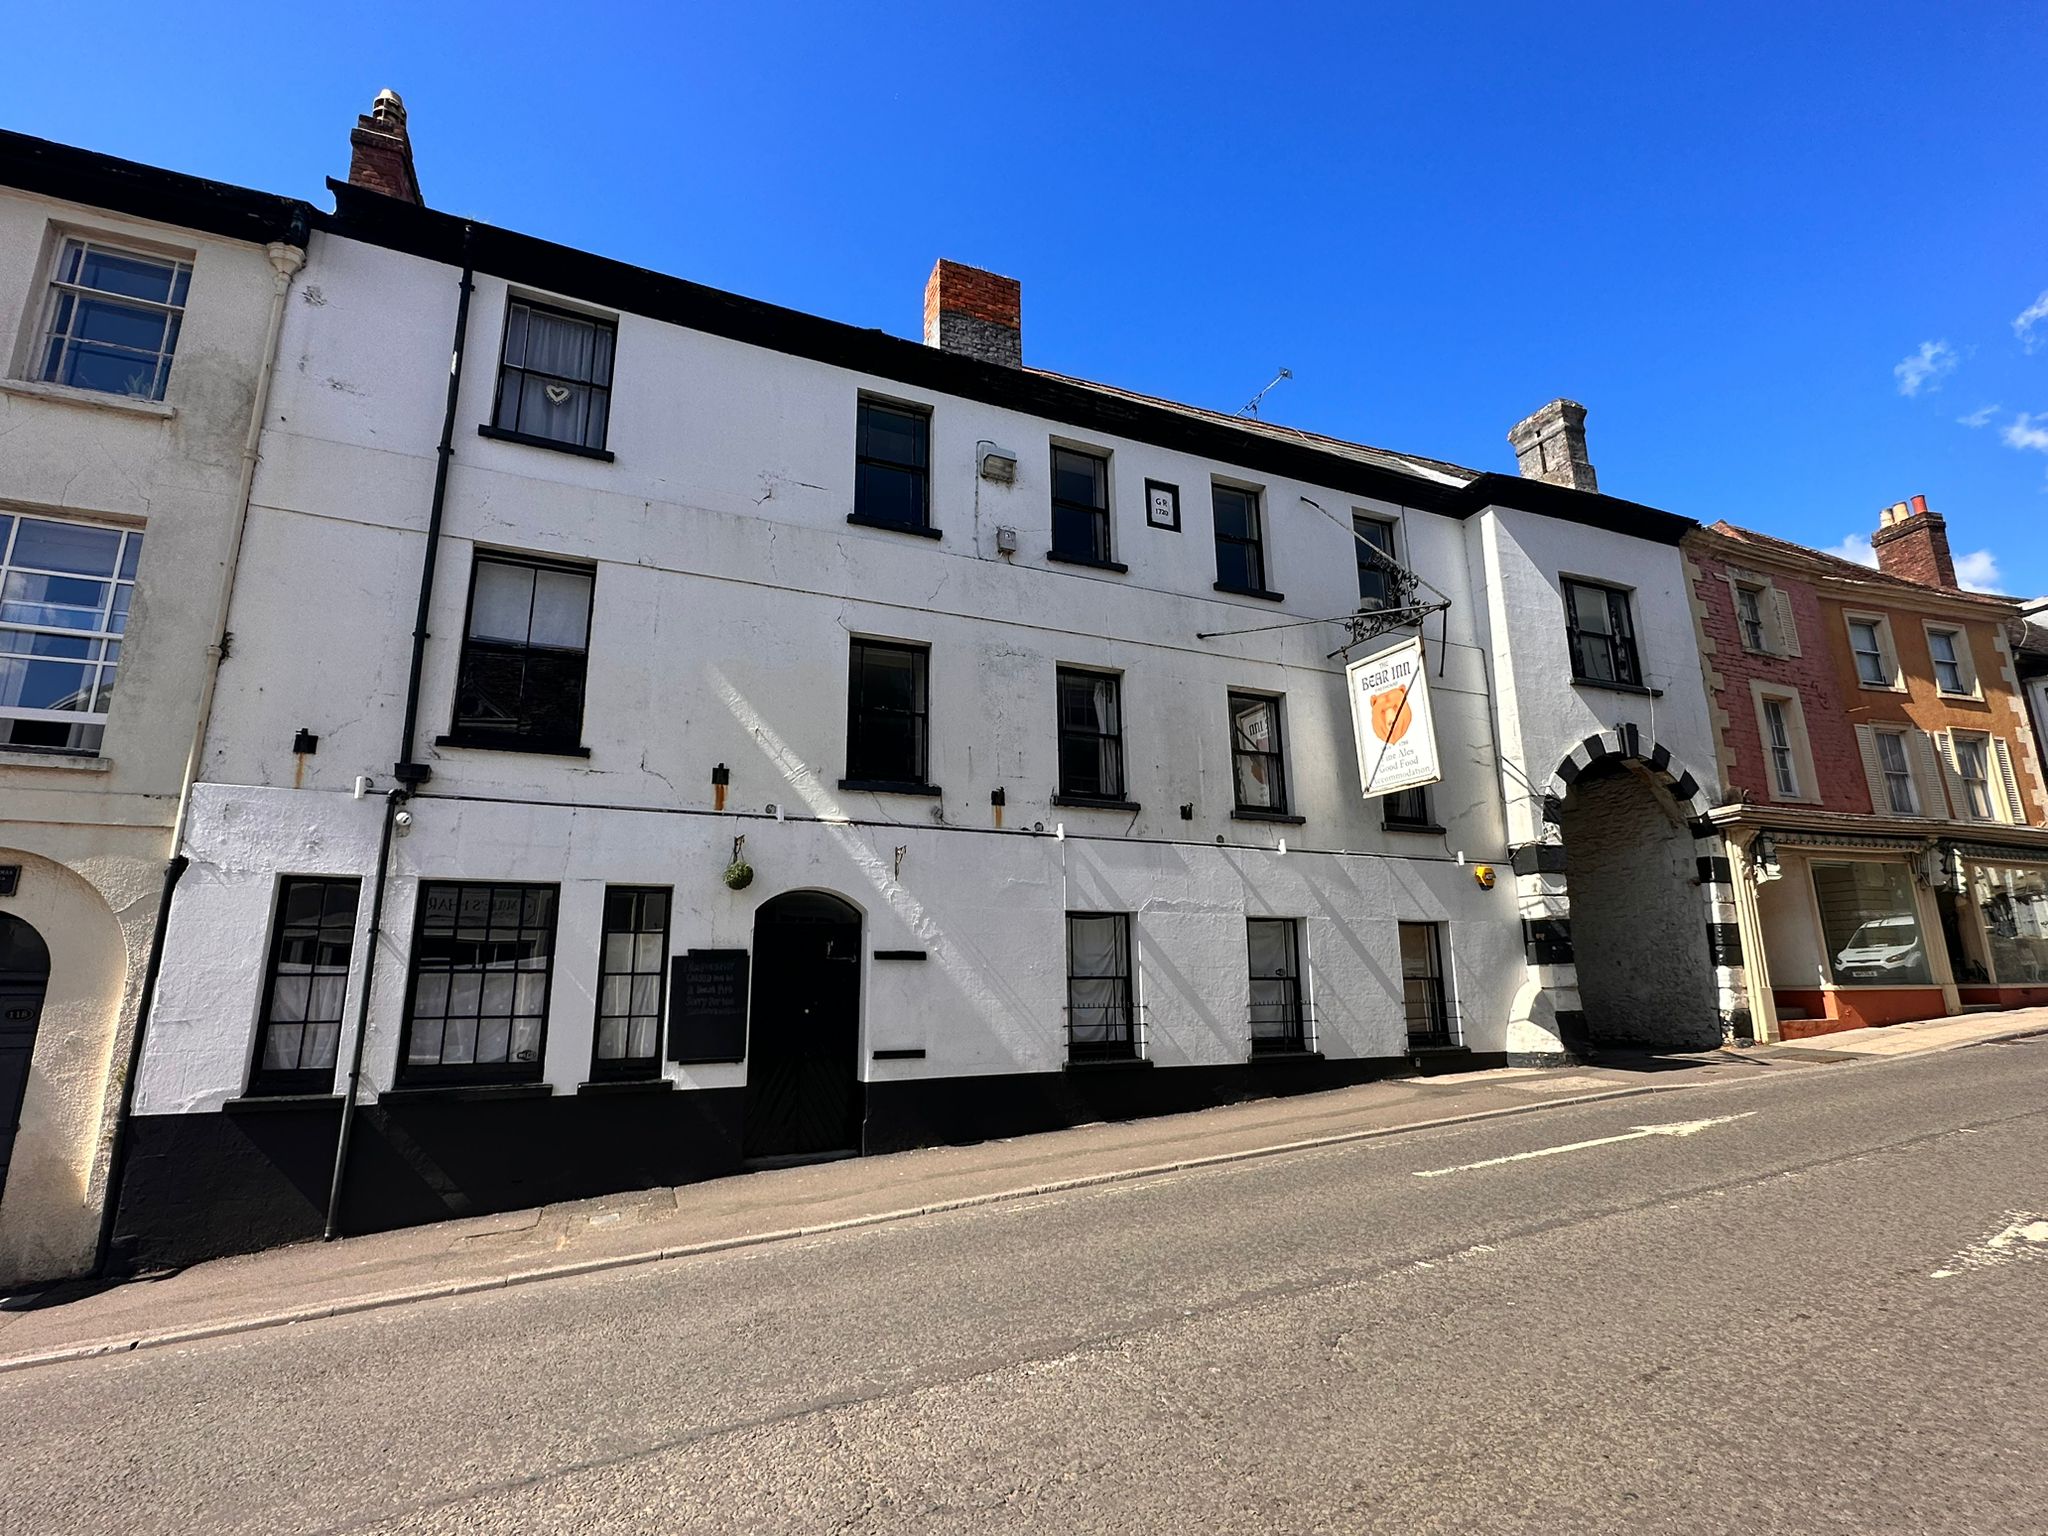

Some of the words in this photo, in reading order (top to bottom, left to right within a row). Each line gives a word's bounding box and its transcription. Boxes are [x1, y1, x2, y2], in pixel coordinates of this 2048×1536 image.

[1361, 669, 1390, 691] BEAR
[1391, 661, 1411, 680] INN
[1400, 756, 1419, 769] Food
